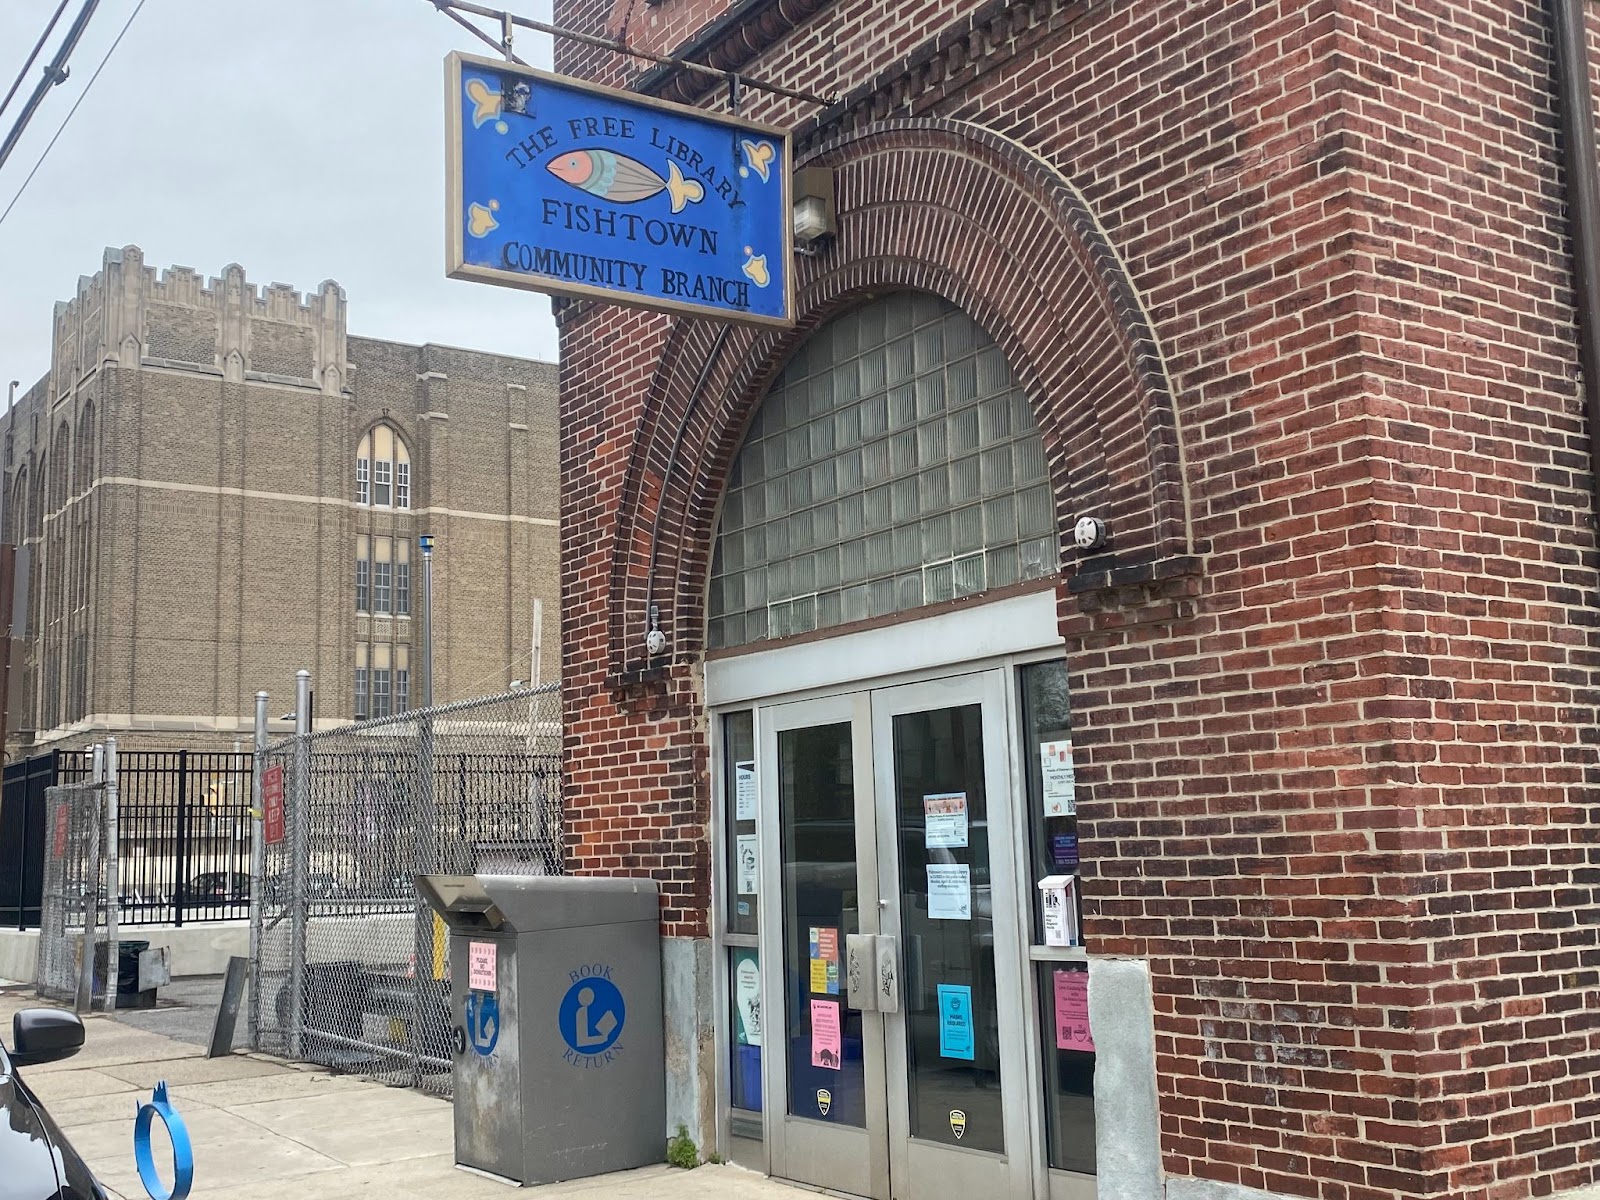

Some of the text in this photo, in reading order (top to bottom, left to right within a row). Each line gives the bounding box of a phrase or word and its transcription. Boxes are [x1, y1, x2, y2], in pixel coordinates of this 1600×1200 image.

[505, 116, 747, 211] THE FREE LIBRARY
[542, 198, 719, 256] FISHTOWN
[503, 241, 751, 308] COMMUNITY BRANCH
[268, 808, 280, 824] KEEP
[569, 963, 614, 984] BOOK
[563, 1041, 624, 1069] RETURN
